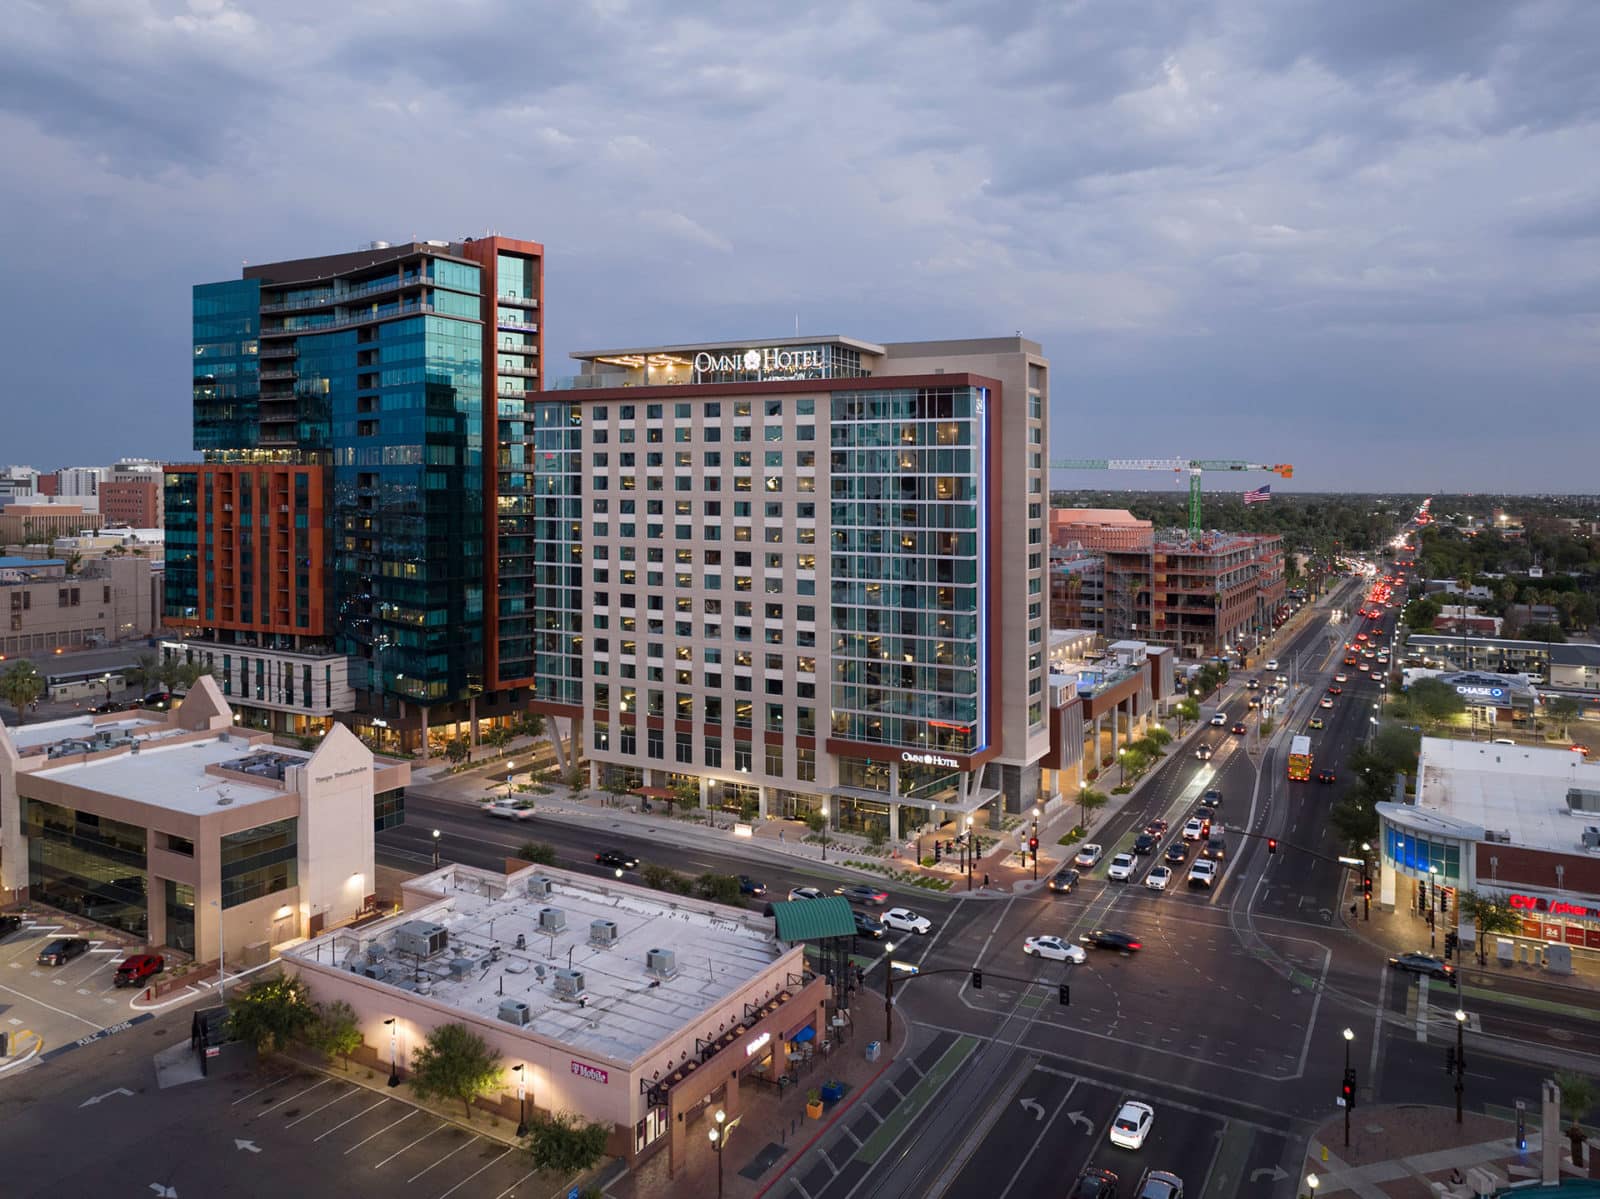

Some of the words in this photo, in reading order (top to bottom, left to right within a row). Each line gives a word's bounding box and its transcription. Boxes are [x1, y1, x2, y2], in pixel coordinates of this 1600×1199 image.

[695, 352, 741, 372] OMNI
[763, 348, 823, 370] HOTEL
[1456, 686, 1491, 696] CHASE
[933, 755, 959, 768] HOTEL
[1509, 893, 1548, 911] CVS
[1545, 927, 1559, 937] 24
